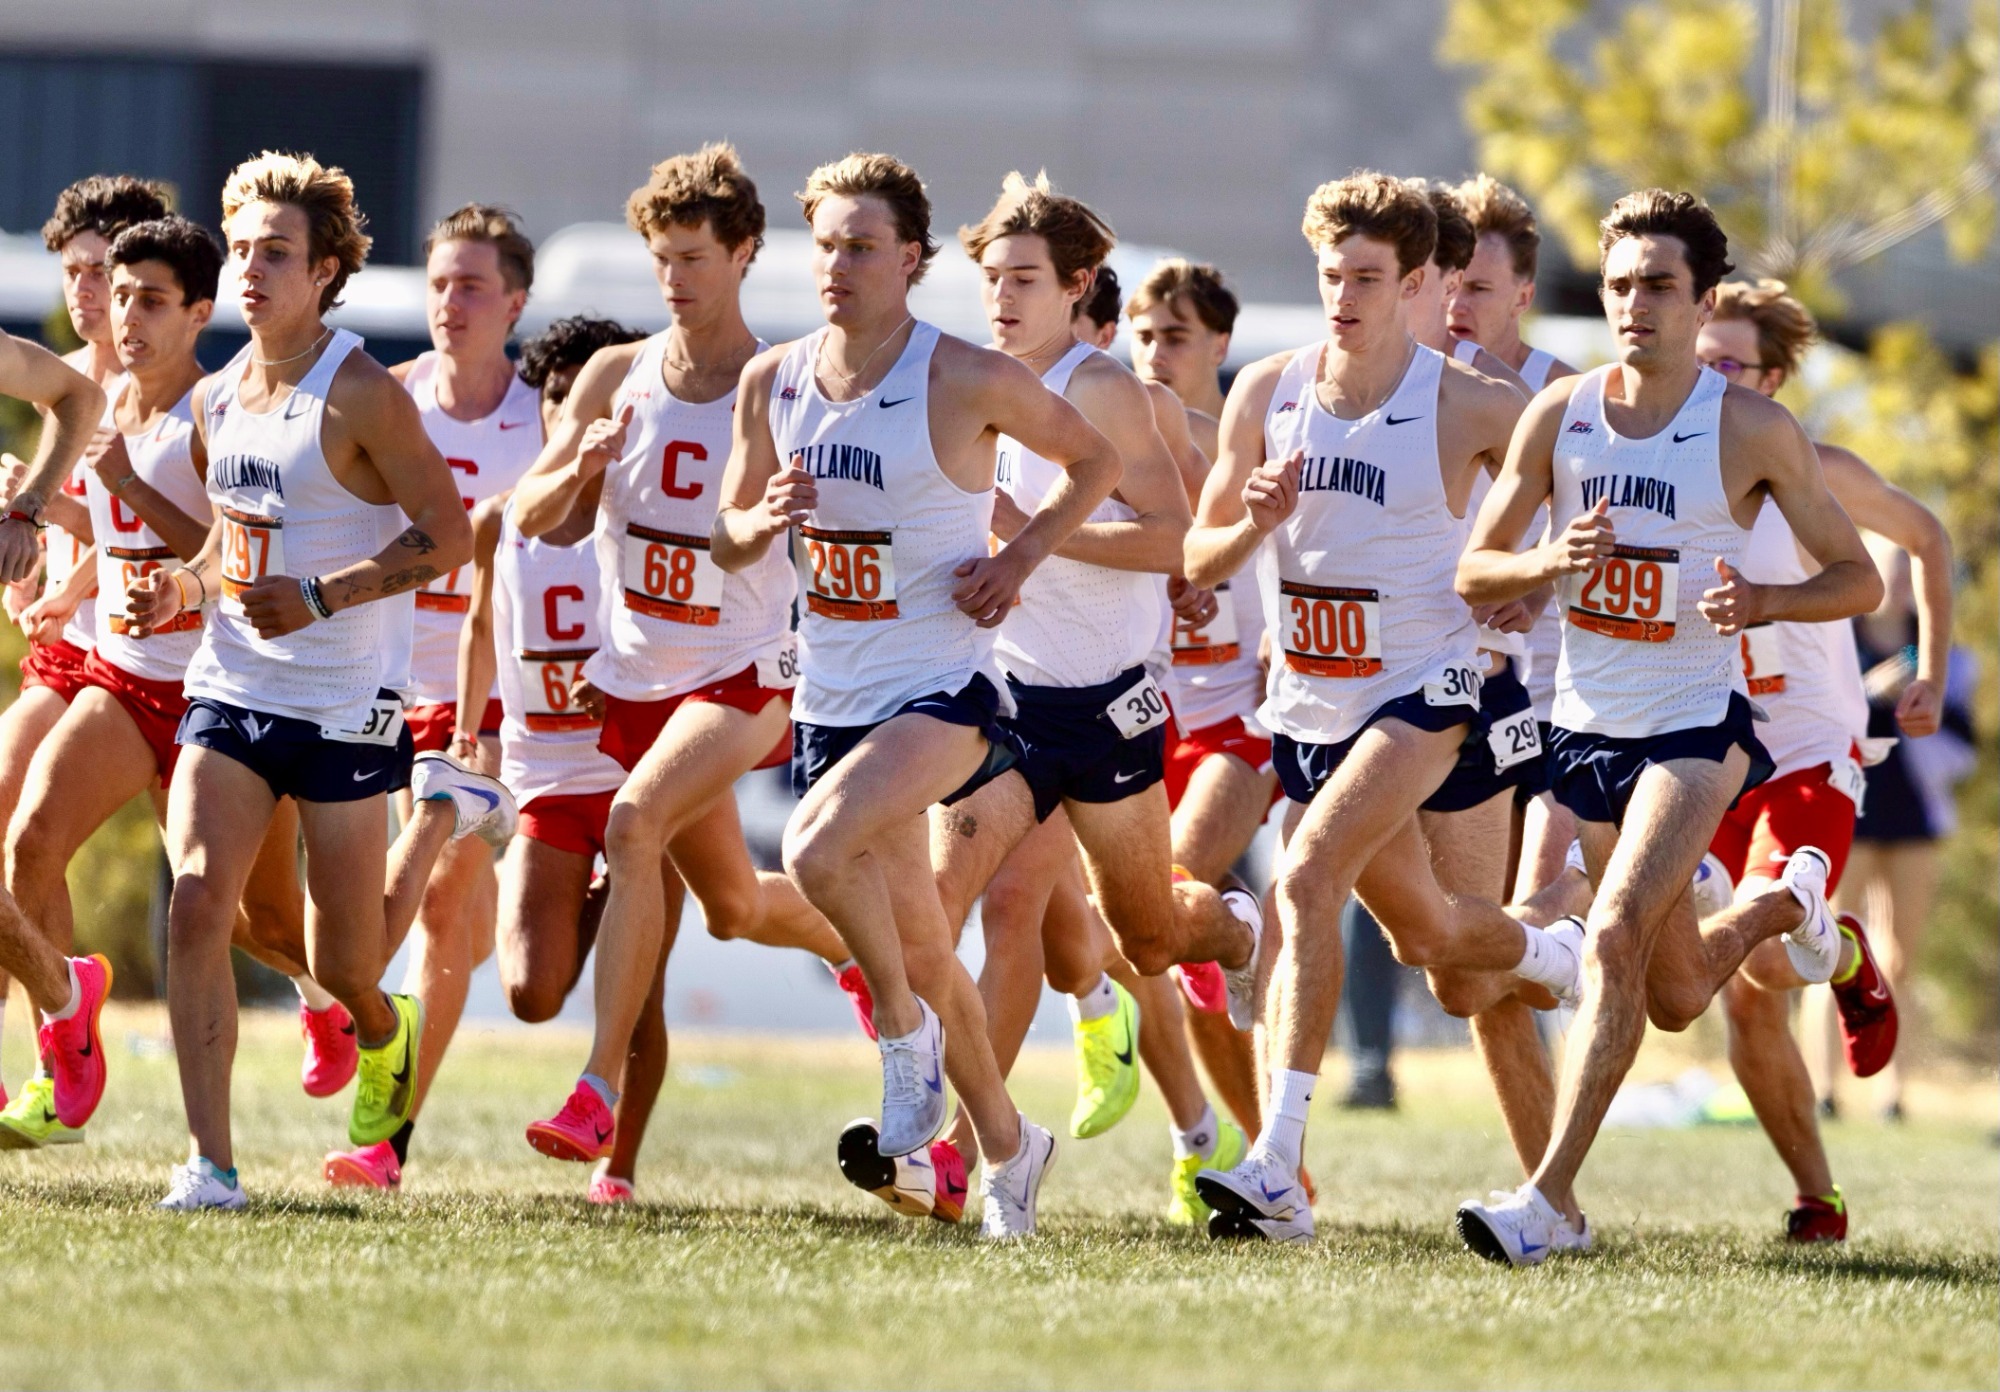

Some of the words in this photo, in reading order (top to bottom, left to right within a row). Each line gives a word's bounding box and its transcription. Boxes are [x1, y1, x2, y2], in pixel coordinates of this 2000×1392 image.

[661, 440, 708, 500] C
[789, 444, 885, 492] LLANOVA
[1298, 457, 1385, 507] ILLANOVA
[226, 520, 271, 580] 297
[643, 542, 697, 602] 68
[809, 540, 882, 600] 296
[544, 585, 585, 641] C
[1581, 558, 1663, 619] 299
[1291, 597, 1366, 656] 300
[362, 707, 395, 737] 97
[1127, 681, 1163, 725] 30
